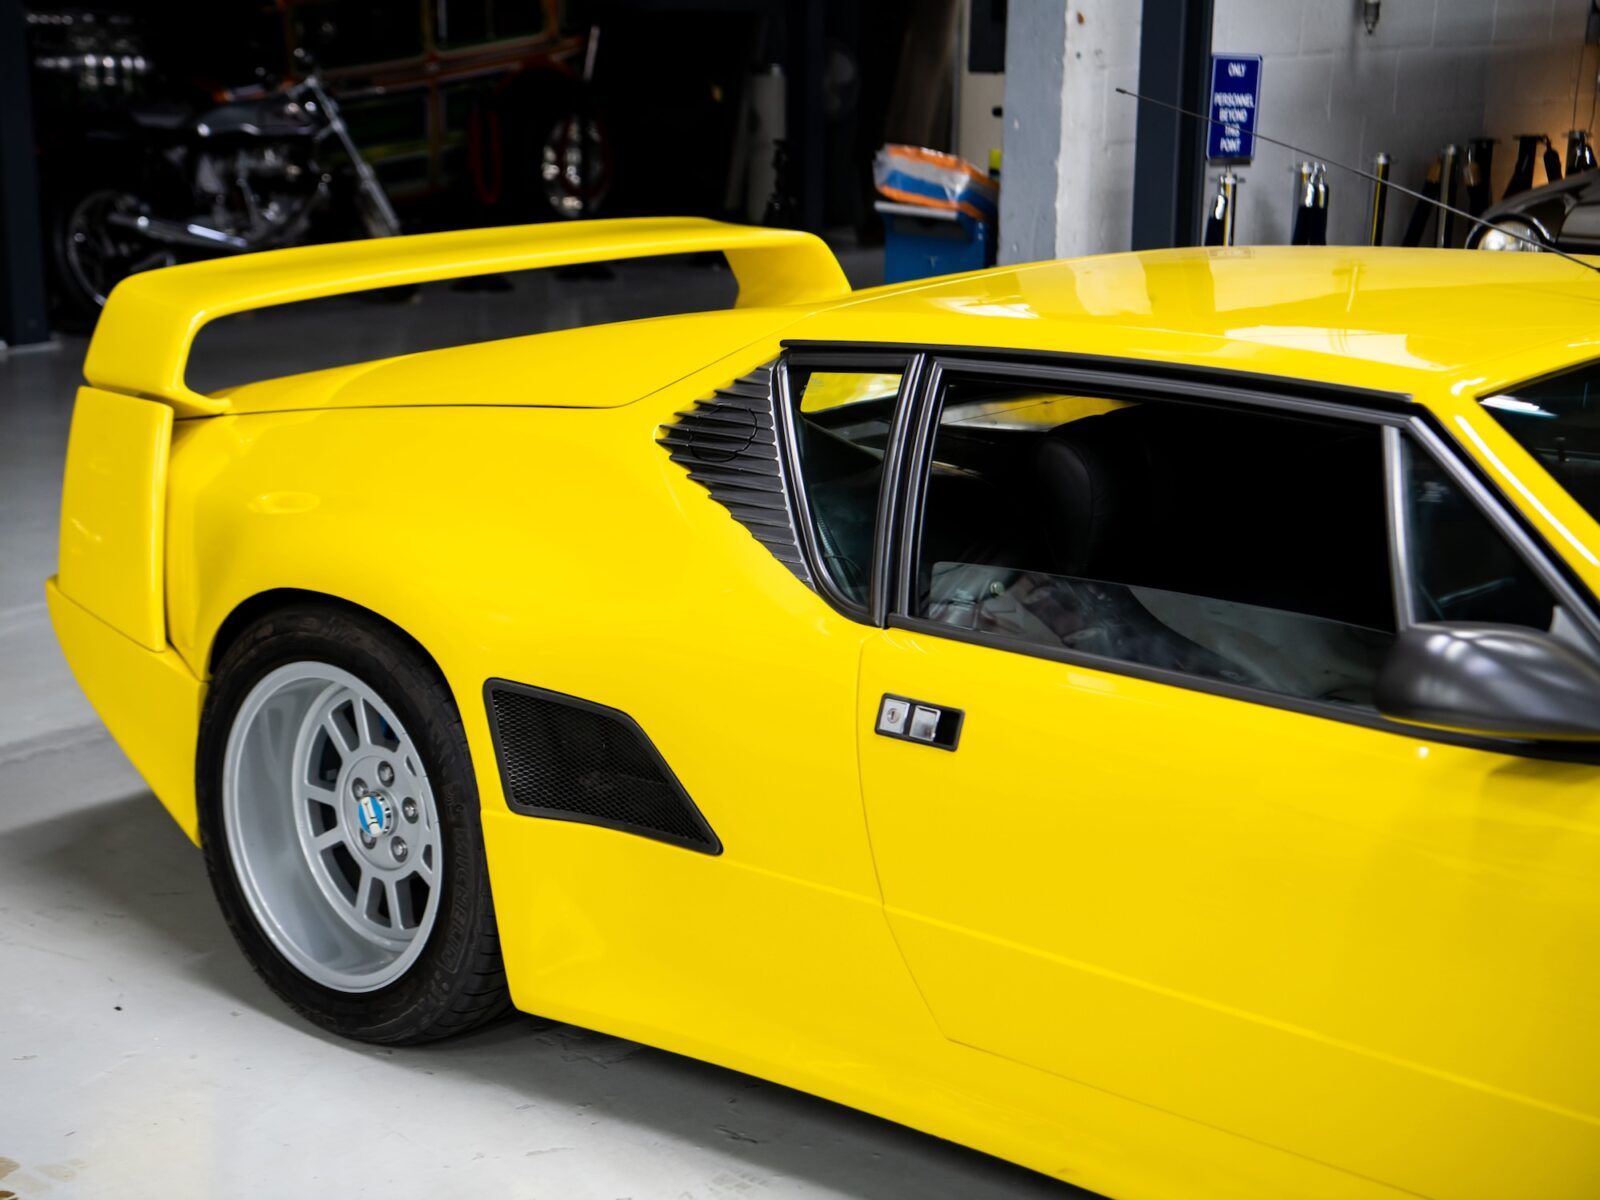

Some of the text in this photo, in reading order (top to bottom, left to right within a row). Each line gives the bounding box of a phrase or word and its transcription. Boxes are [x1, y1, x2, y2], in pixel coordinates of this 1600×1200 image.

[1228, 62, 1246, 77] ONLY
[1214, 92, 1255, 108] PERSONNEL
[1219, 108, 1248, 123] BEYOND
[1220, 137, 1241, 153] POINT
[441, 828, 471, 968] MICHELIN
